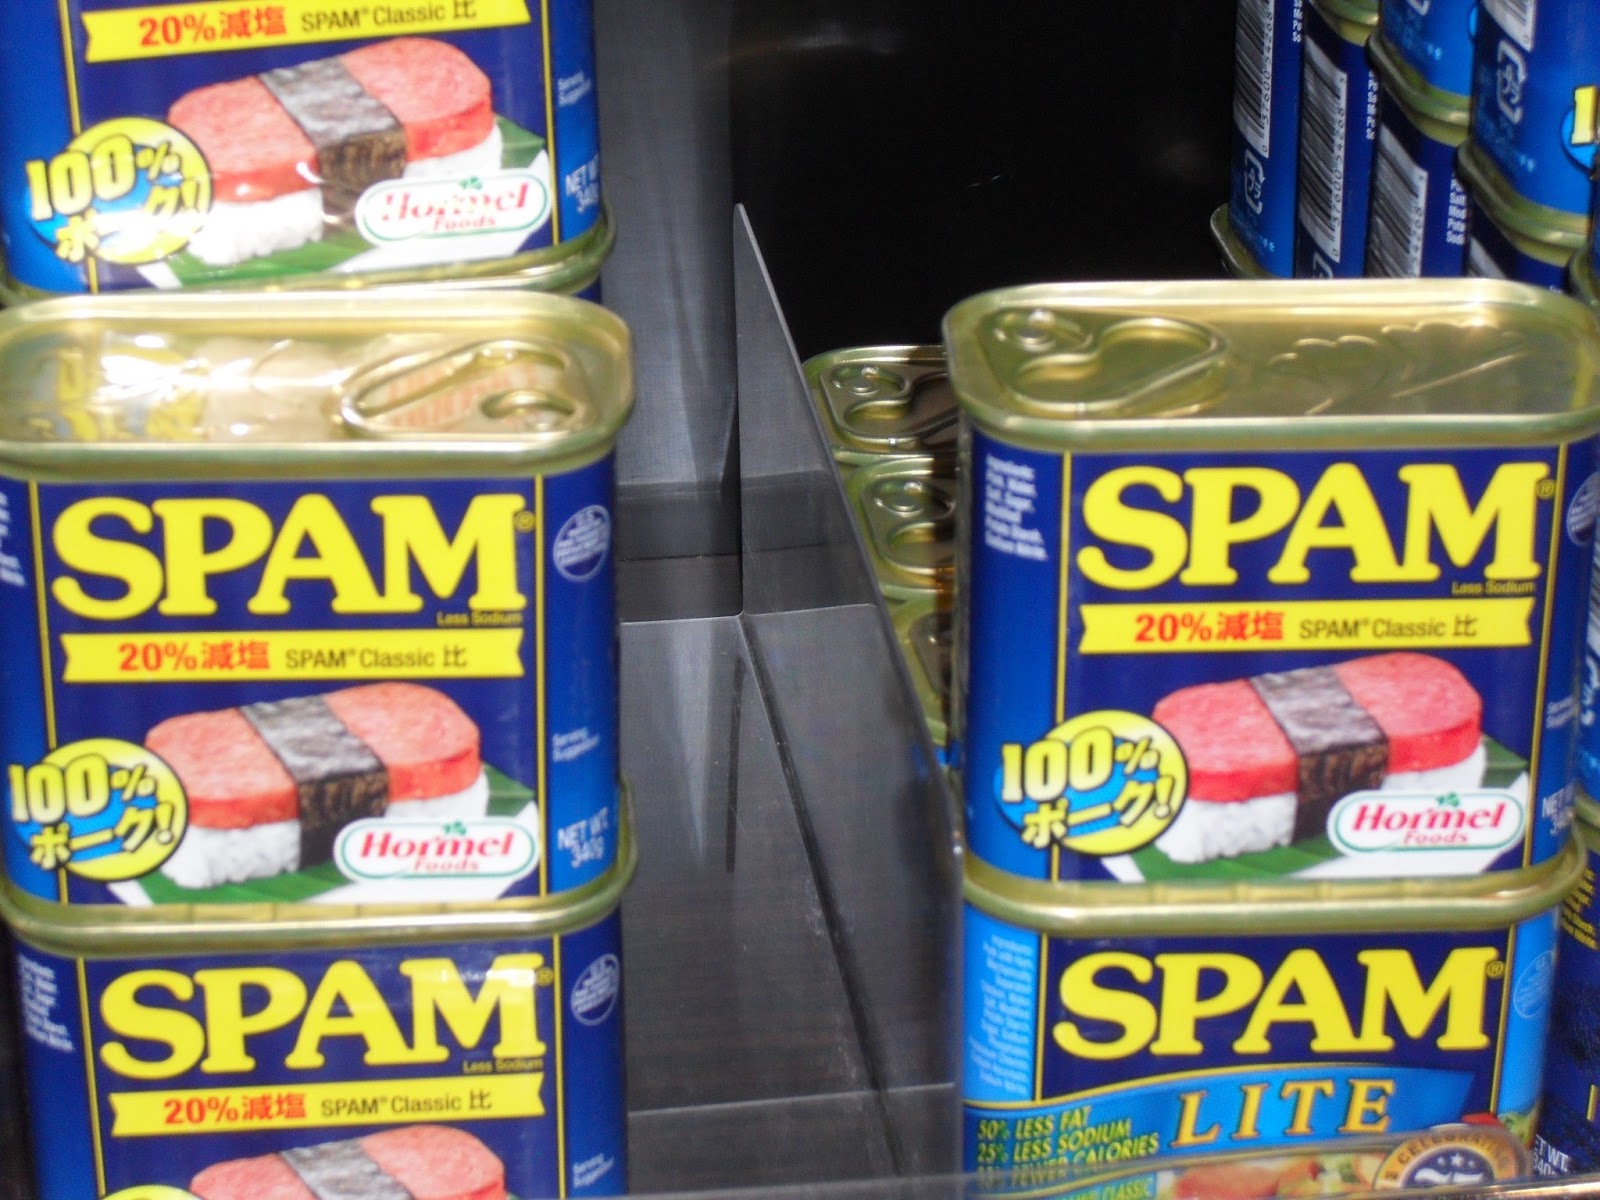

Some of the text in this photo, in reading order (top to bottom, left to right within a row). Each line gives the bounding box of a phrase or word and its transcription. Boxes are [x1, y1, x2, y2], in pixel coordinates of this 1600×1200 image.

[373, 4, 446, 25] Classic
[26, 132, 181, 221] 100%
[1134, 611, 1285, 643] 20%減塩
[1372, 618, 1446, 638] Classic
[1453, 614, 1478, 638] 比
[118, 640, 272, 672] 20%減塩
[359, 648, 435, 669] Classic
[444, 645, 468, 668] 比
[1002, 727, 1160, 803] 100%
[9, 753, 157, 824] 100%
[1351, 801, 1508, 834] Hormel
[358, 828, 515, 860] Hormel
[1403, 829, 1470, 845] Foods
[412, 857, 481, 875] Foods
[163, 1093, 307, 1125] 20%減塩
[390, 1094, 462, 1114] Classic
[469, 1089, 493, 1110] 比
[1014, 1114, 1055, 1141] LESS
[1059, 1104, 1093, 1132] FAT
[1170, 1078, 1399, 1149] LITE
[1013, 1137, 1053, 1164] LESS
[1057, 1117, 1133, 1155] SODIUM
